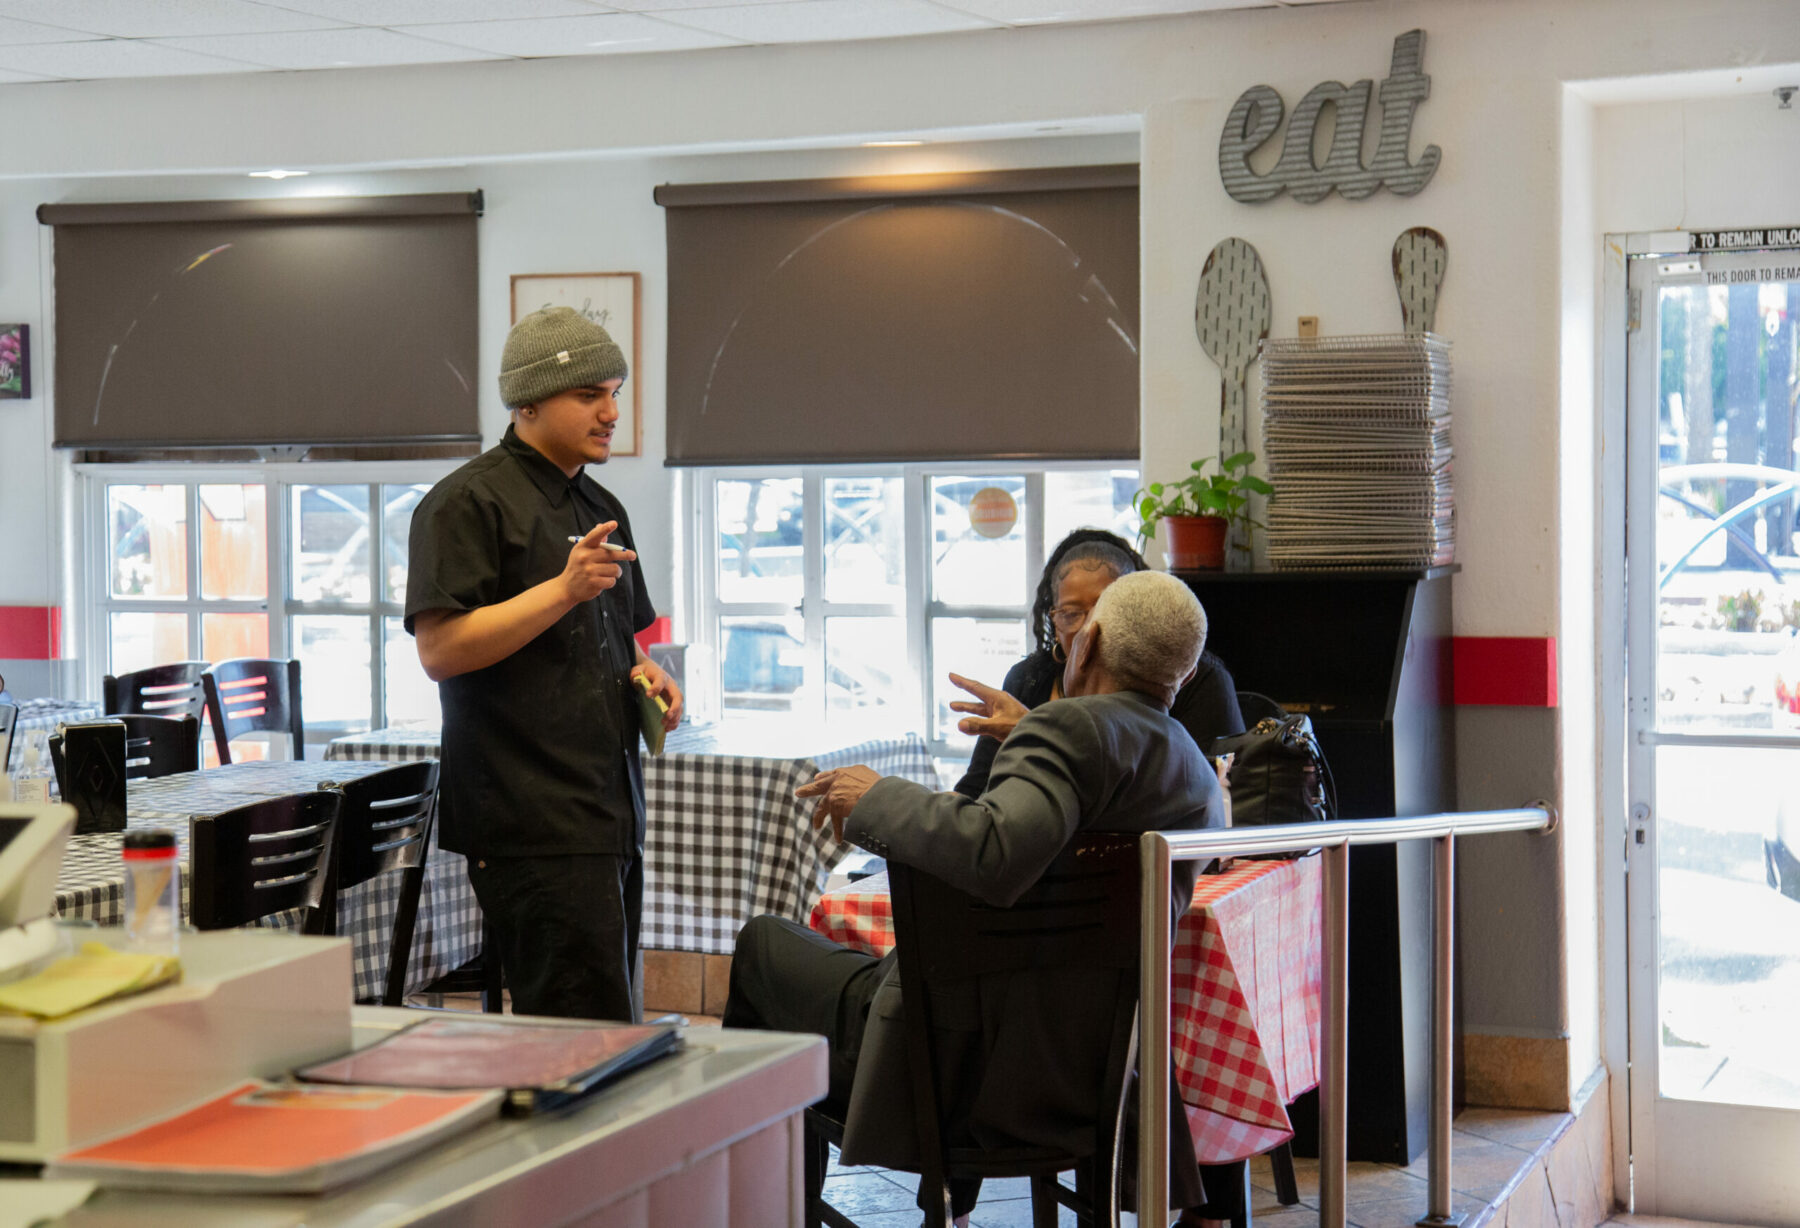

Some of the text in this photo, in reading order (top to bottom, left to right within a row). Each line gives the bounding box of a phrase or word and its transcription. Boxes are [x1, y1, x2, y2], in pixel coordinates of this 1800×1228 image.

[1218, 28, 1442, 204] eat
[1701, 233, 1715, 248] TO
[1719, 230, 1764, 247] REMAIN
[1767, 228, 1800, 245] UNLO
[1707, 271, 1727, 284] THIS
[1730, 269, 1756, 283] DOOR
[1759, 268, 1772, 281] TO
